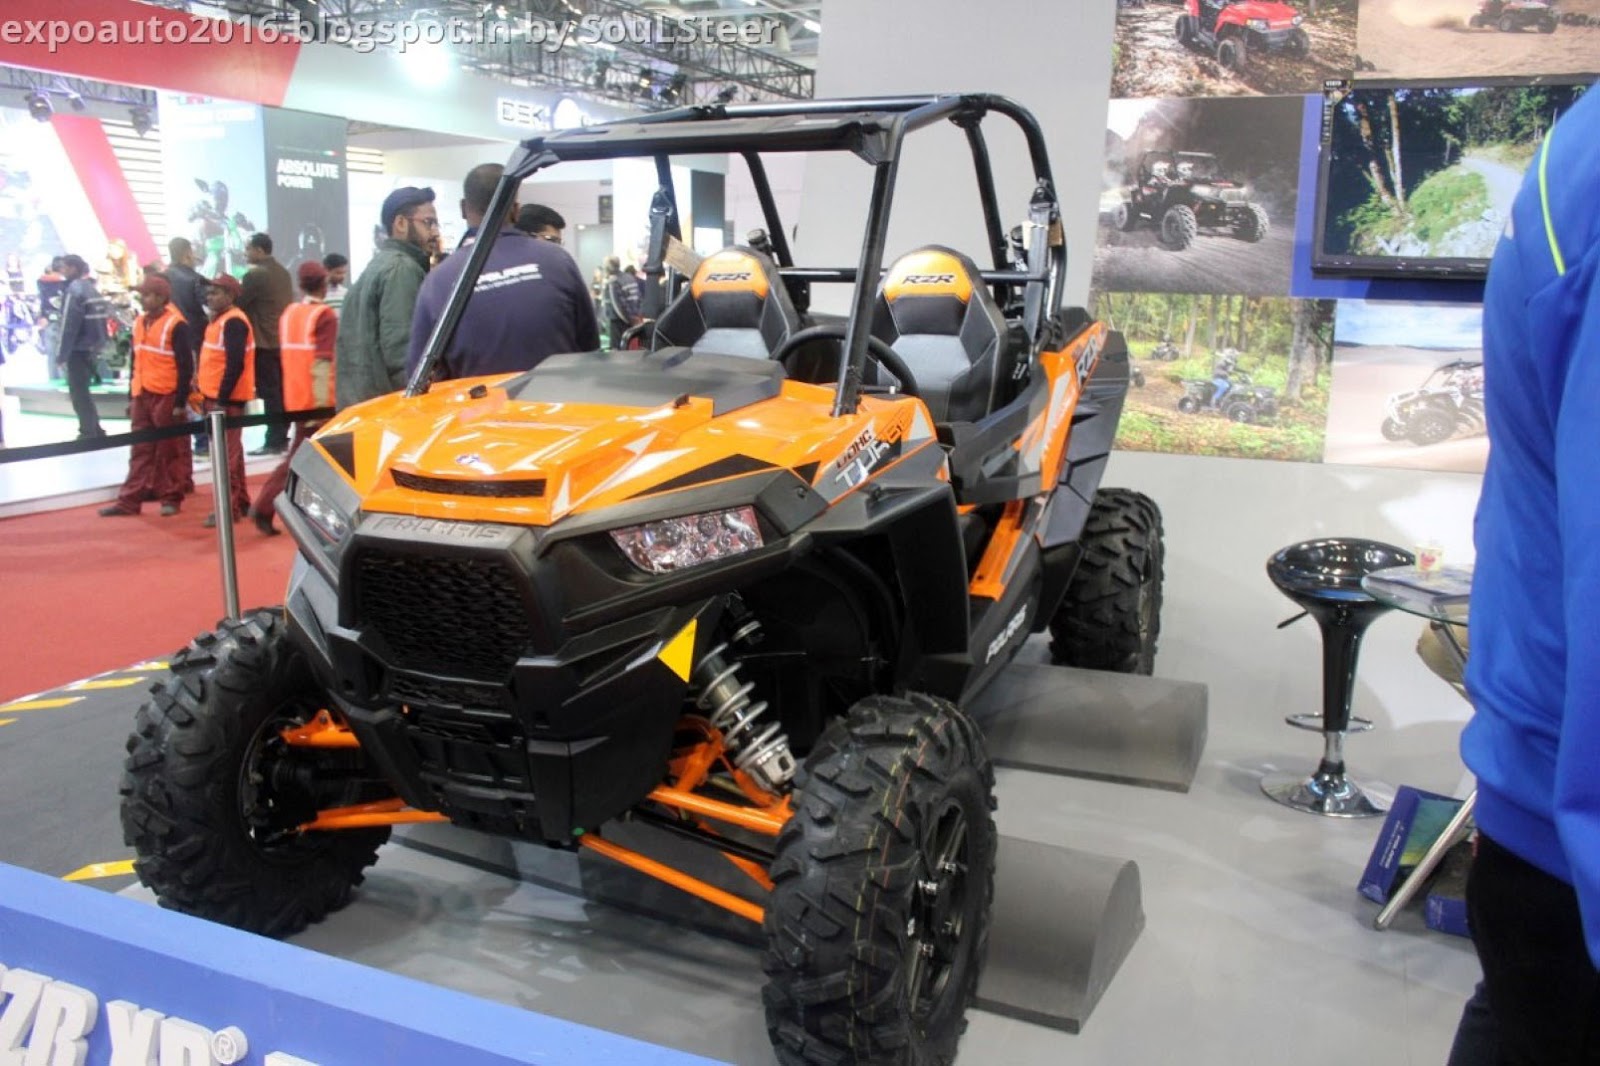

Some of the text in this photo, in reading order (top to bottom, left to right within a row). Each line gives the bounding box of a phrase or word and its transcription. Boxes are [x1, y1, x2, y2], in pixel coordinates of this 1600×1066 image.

[276, 158, 339, 179] ABSOLUTE
[705, 272, 750, 284] RZR
[901, 273, 955, 285] RZR
[373, 516, 505, 539] POLARIS
[0, 964, 98, 1066] ZR
